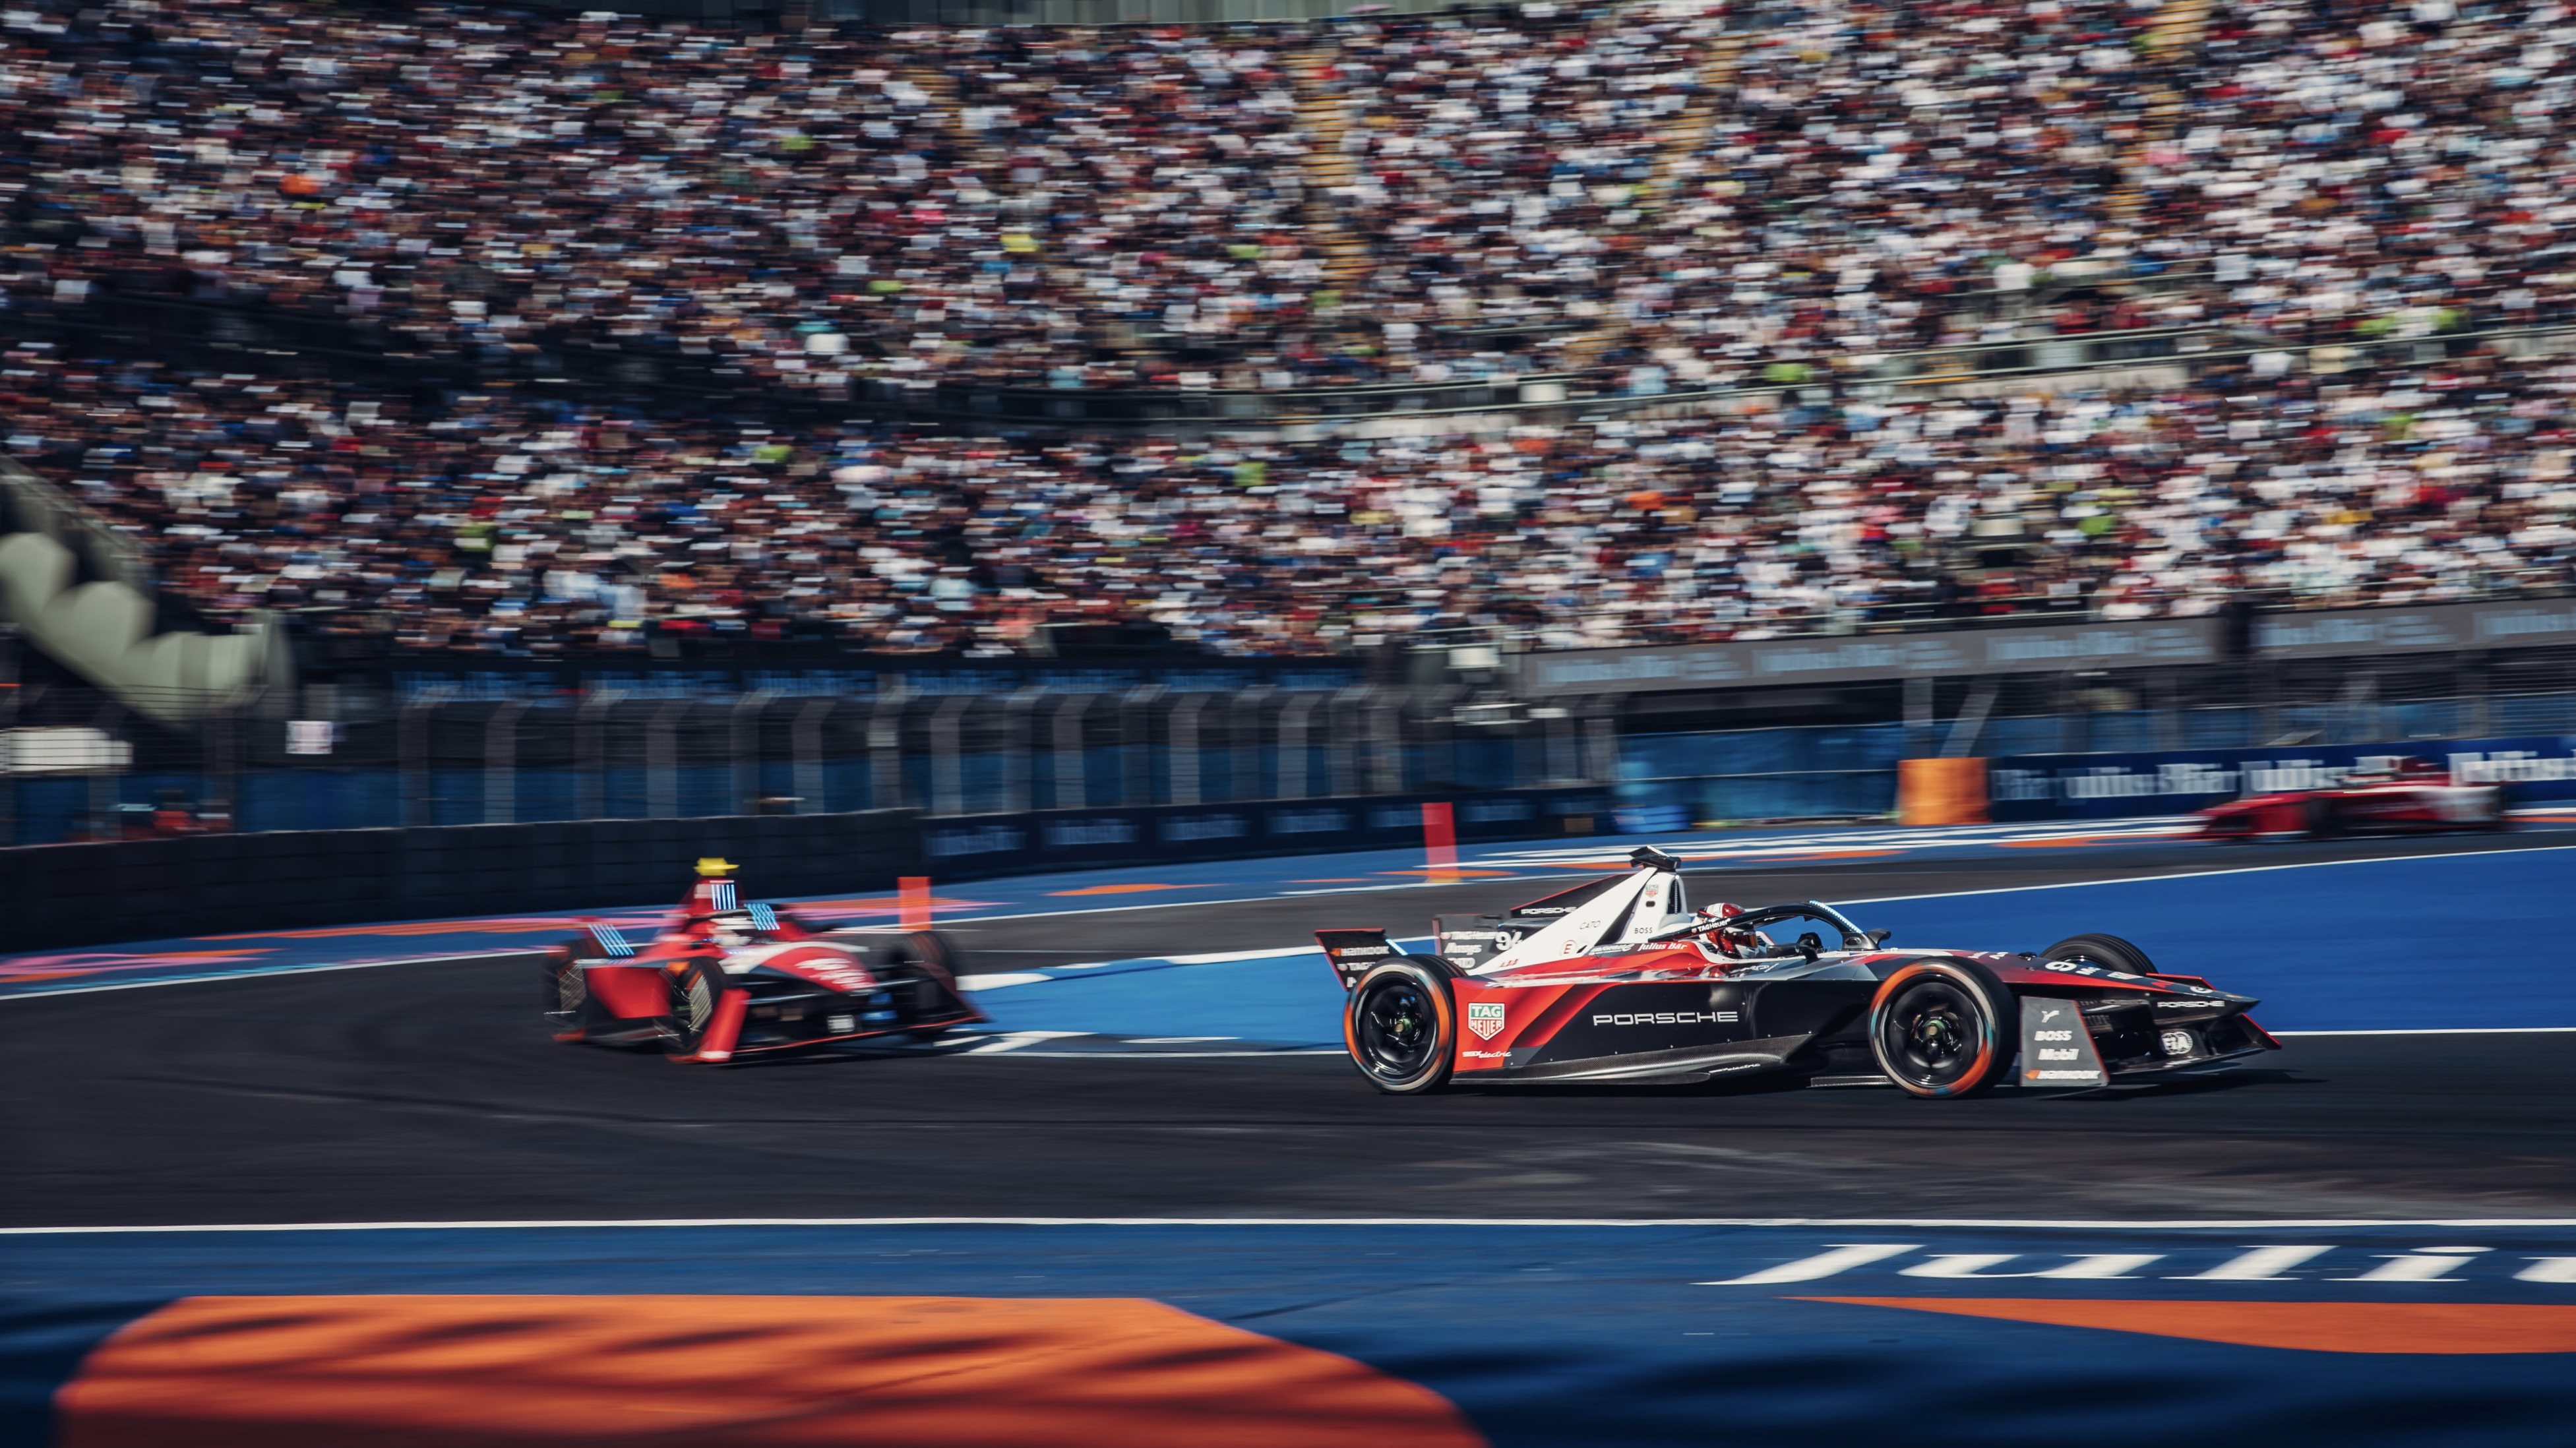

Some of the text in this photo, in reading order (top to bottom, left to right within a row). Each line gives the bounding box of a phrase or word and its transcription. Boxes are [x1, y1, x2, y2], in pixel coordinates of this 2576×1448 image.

[1471, 1006, 1501, 1017] TAG
[1593, 1011, 1738, 1026] PORSCHE
[1471, 1020, 1502, 1037] HEUER
[2034, 1030, 2072, 1041] BOSS
[1690, 1244, 2576, 1285] Juli
